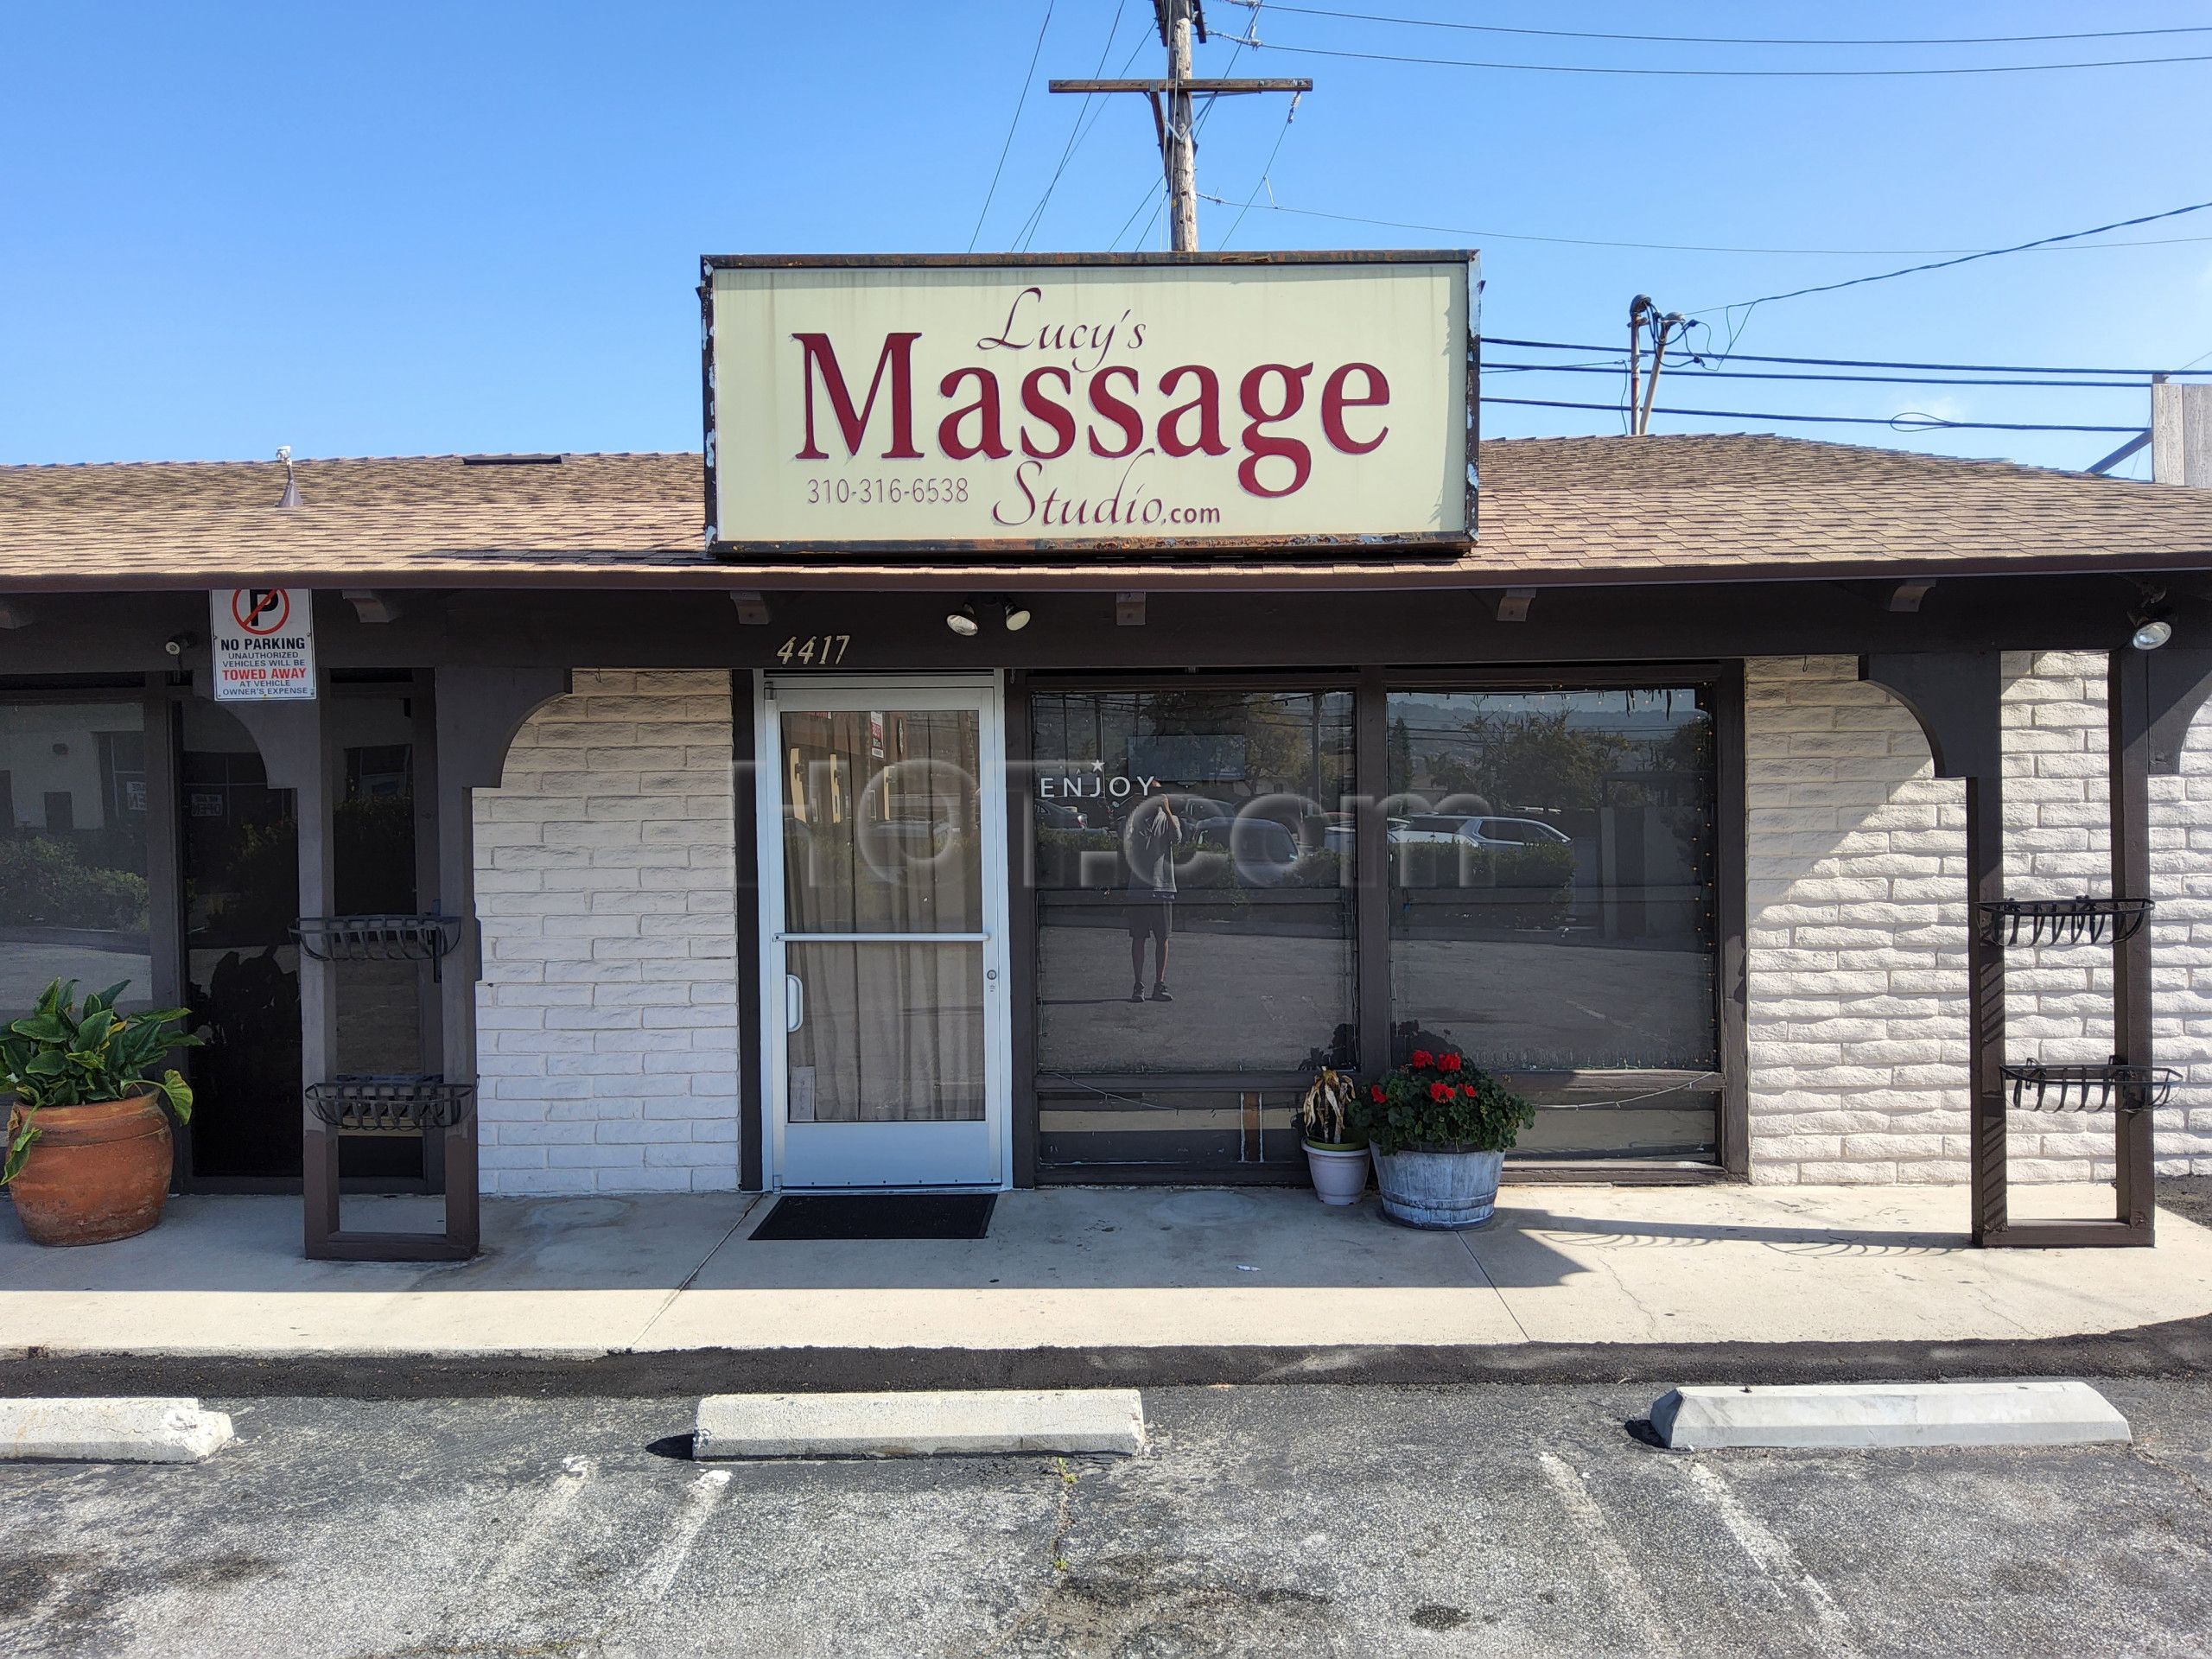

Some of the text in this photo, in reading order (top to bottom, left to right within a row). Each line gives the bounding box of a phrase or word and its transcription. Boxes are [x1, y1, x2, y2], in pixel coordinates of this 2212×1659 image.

[977, 288, 1147, 372] Lucy's
[791, 332, 1391, 499] Massage
[807, 477, 969, 505] 310-316-6538
[220, 638, 305, 651] NO PARKING
[776, 635, 850, 665] 4417
[222, 667, 307, 680] TOWED AWAY
[1040, 776, 1154, 798] ENJOY
